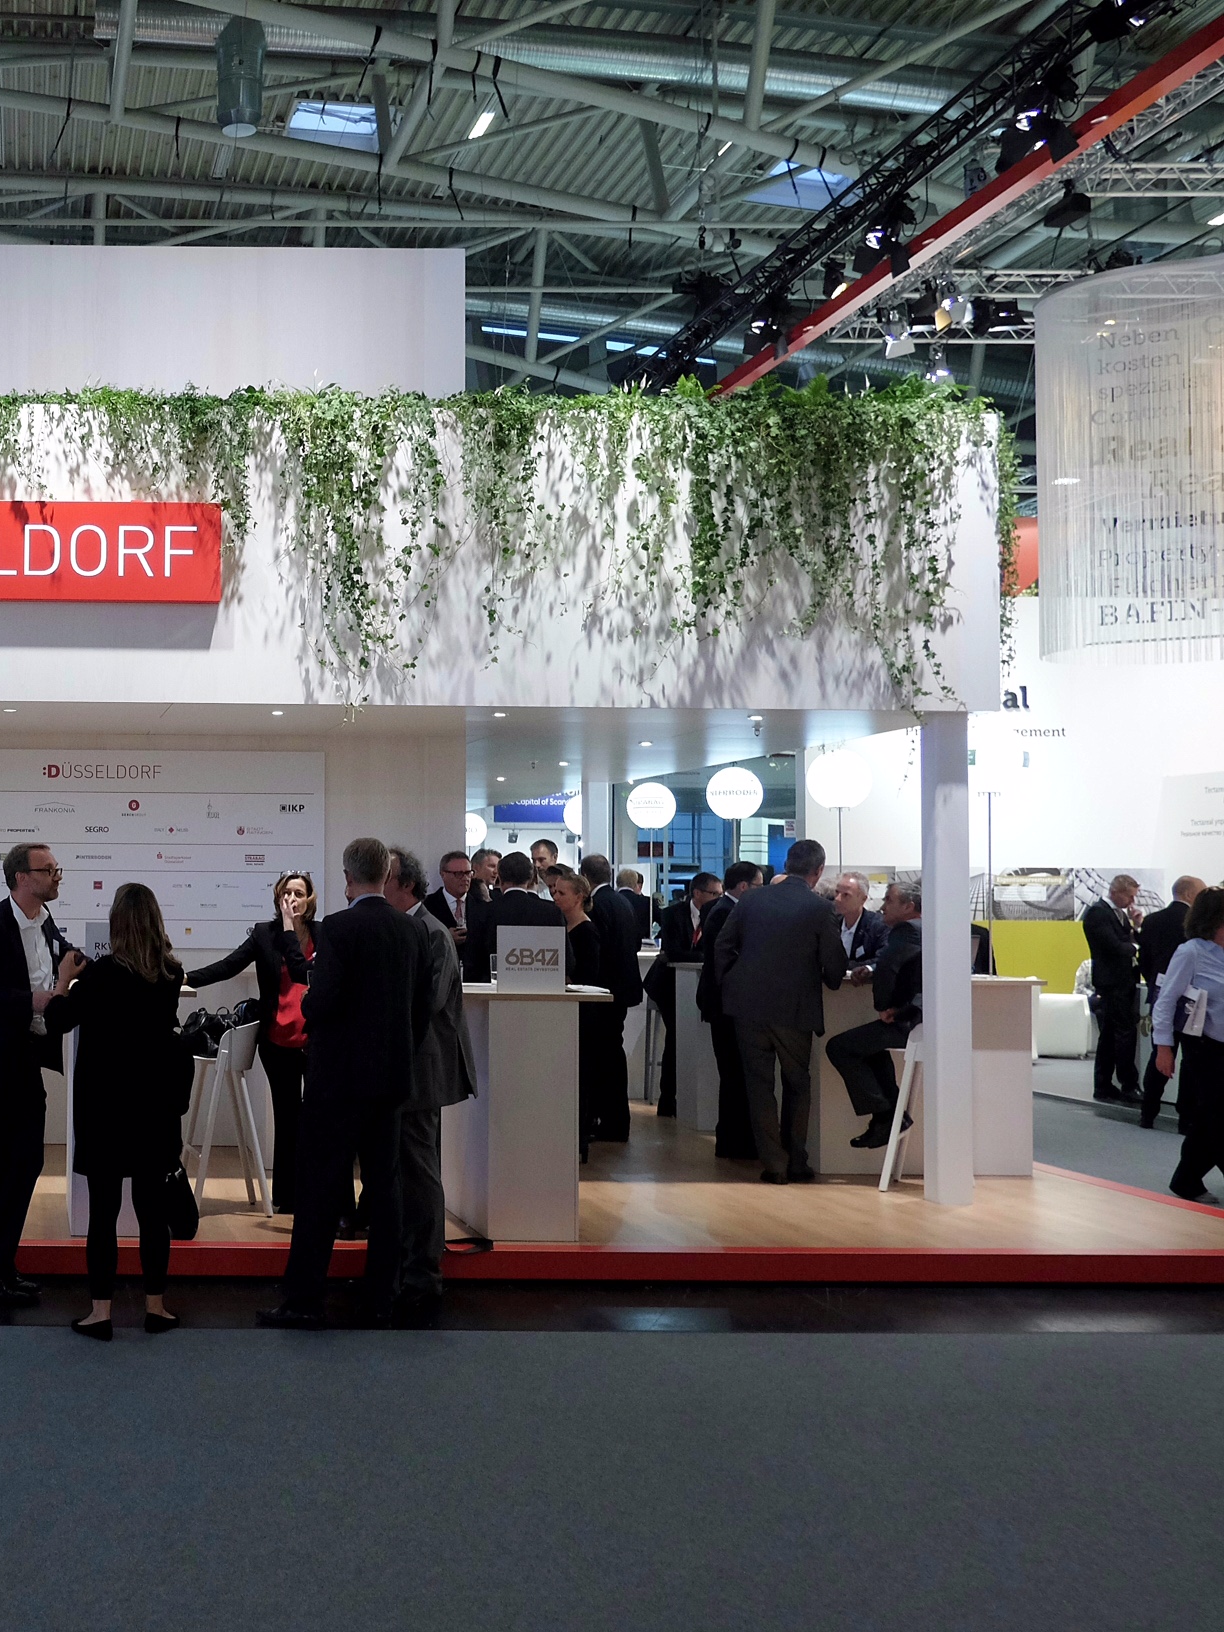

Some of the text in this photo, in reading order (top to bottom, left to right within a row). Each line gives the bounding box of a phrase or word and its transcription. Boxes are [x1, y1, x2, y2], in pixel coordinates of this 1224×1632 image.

[1097, 326, 1180, 350] Neben
[1097, 353, 1182, 375] kosten
[288, 804, 305, 812] IKP
[84, 825, 110, 833] SEGRO
